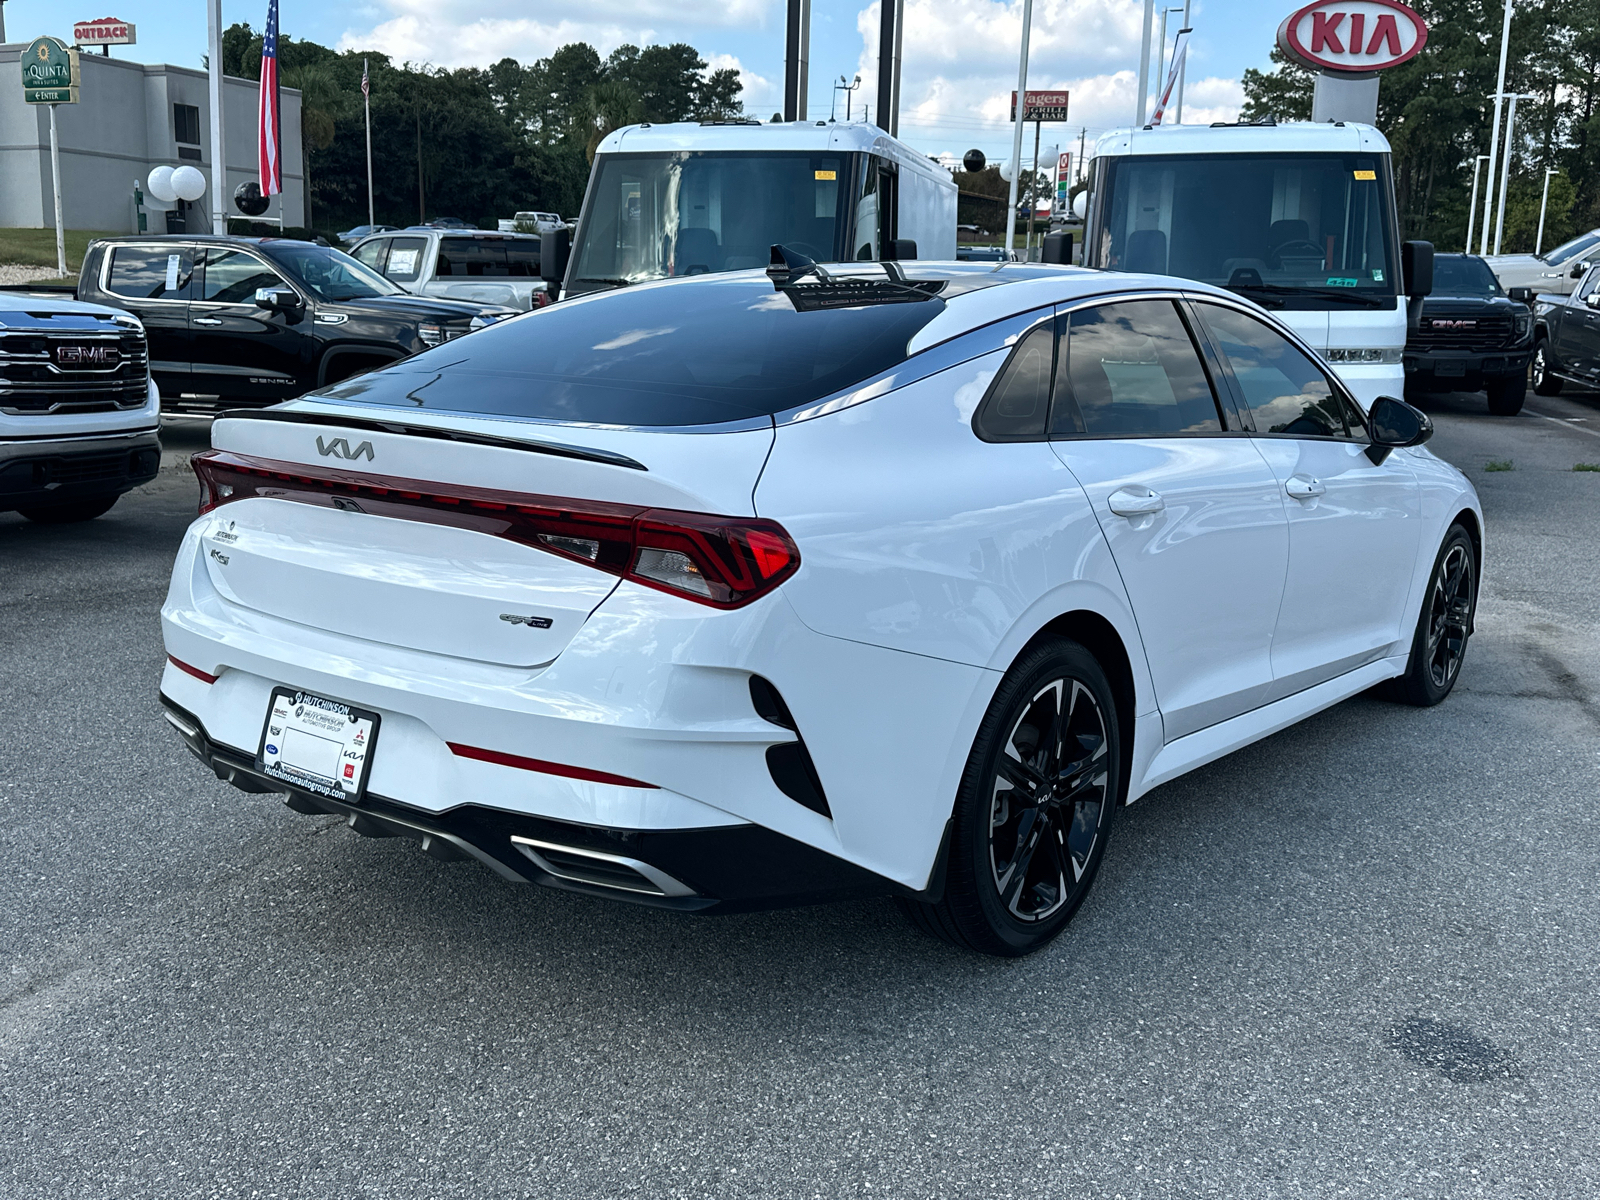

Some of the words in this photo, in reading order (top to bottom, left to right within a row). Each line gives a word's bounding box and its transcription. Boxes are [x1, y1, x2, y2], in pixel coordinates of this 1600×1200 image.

[74, 26, 128, 40] OUTBACK
[1311, 11, 1402, 56] KIA
[30, 64, 68, 80] QUINTA
[41, 91, 59, 100] ENTER
[1432, 319, 1477, 329] GMC
[57, 346, 118, 363] GMC
[249, 377, 297, 385] DENALI
[316, 435, 375, 462] KIA
[303, 694, 350, 716] HUTCHINSON
[264, 764, 346, 800] Hutchinsonautogroup.com
